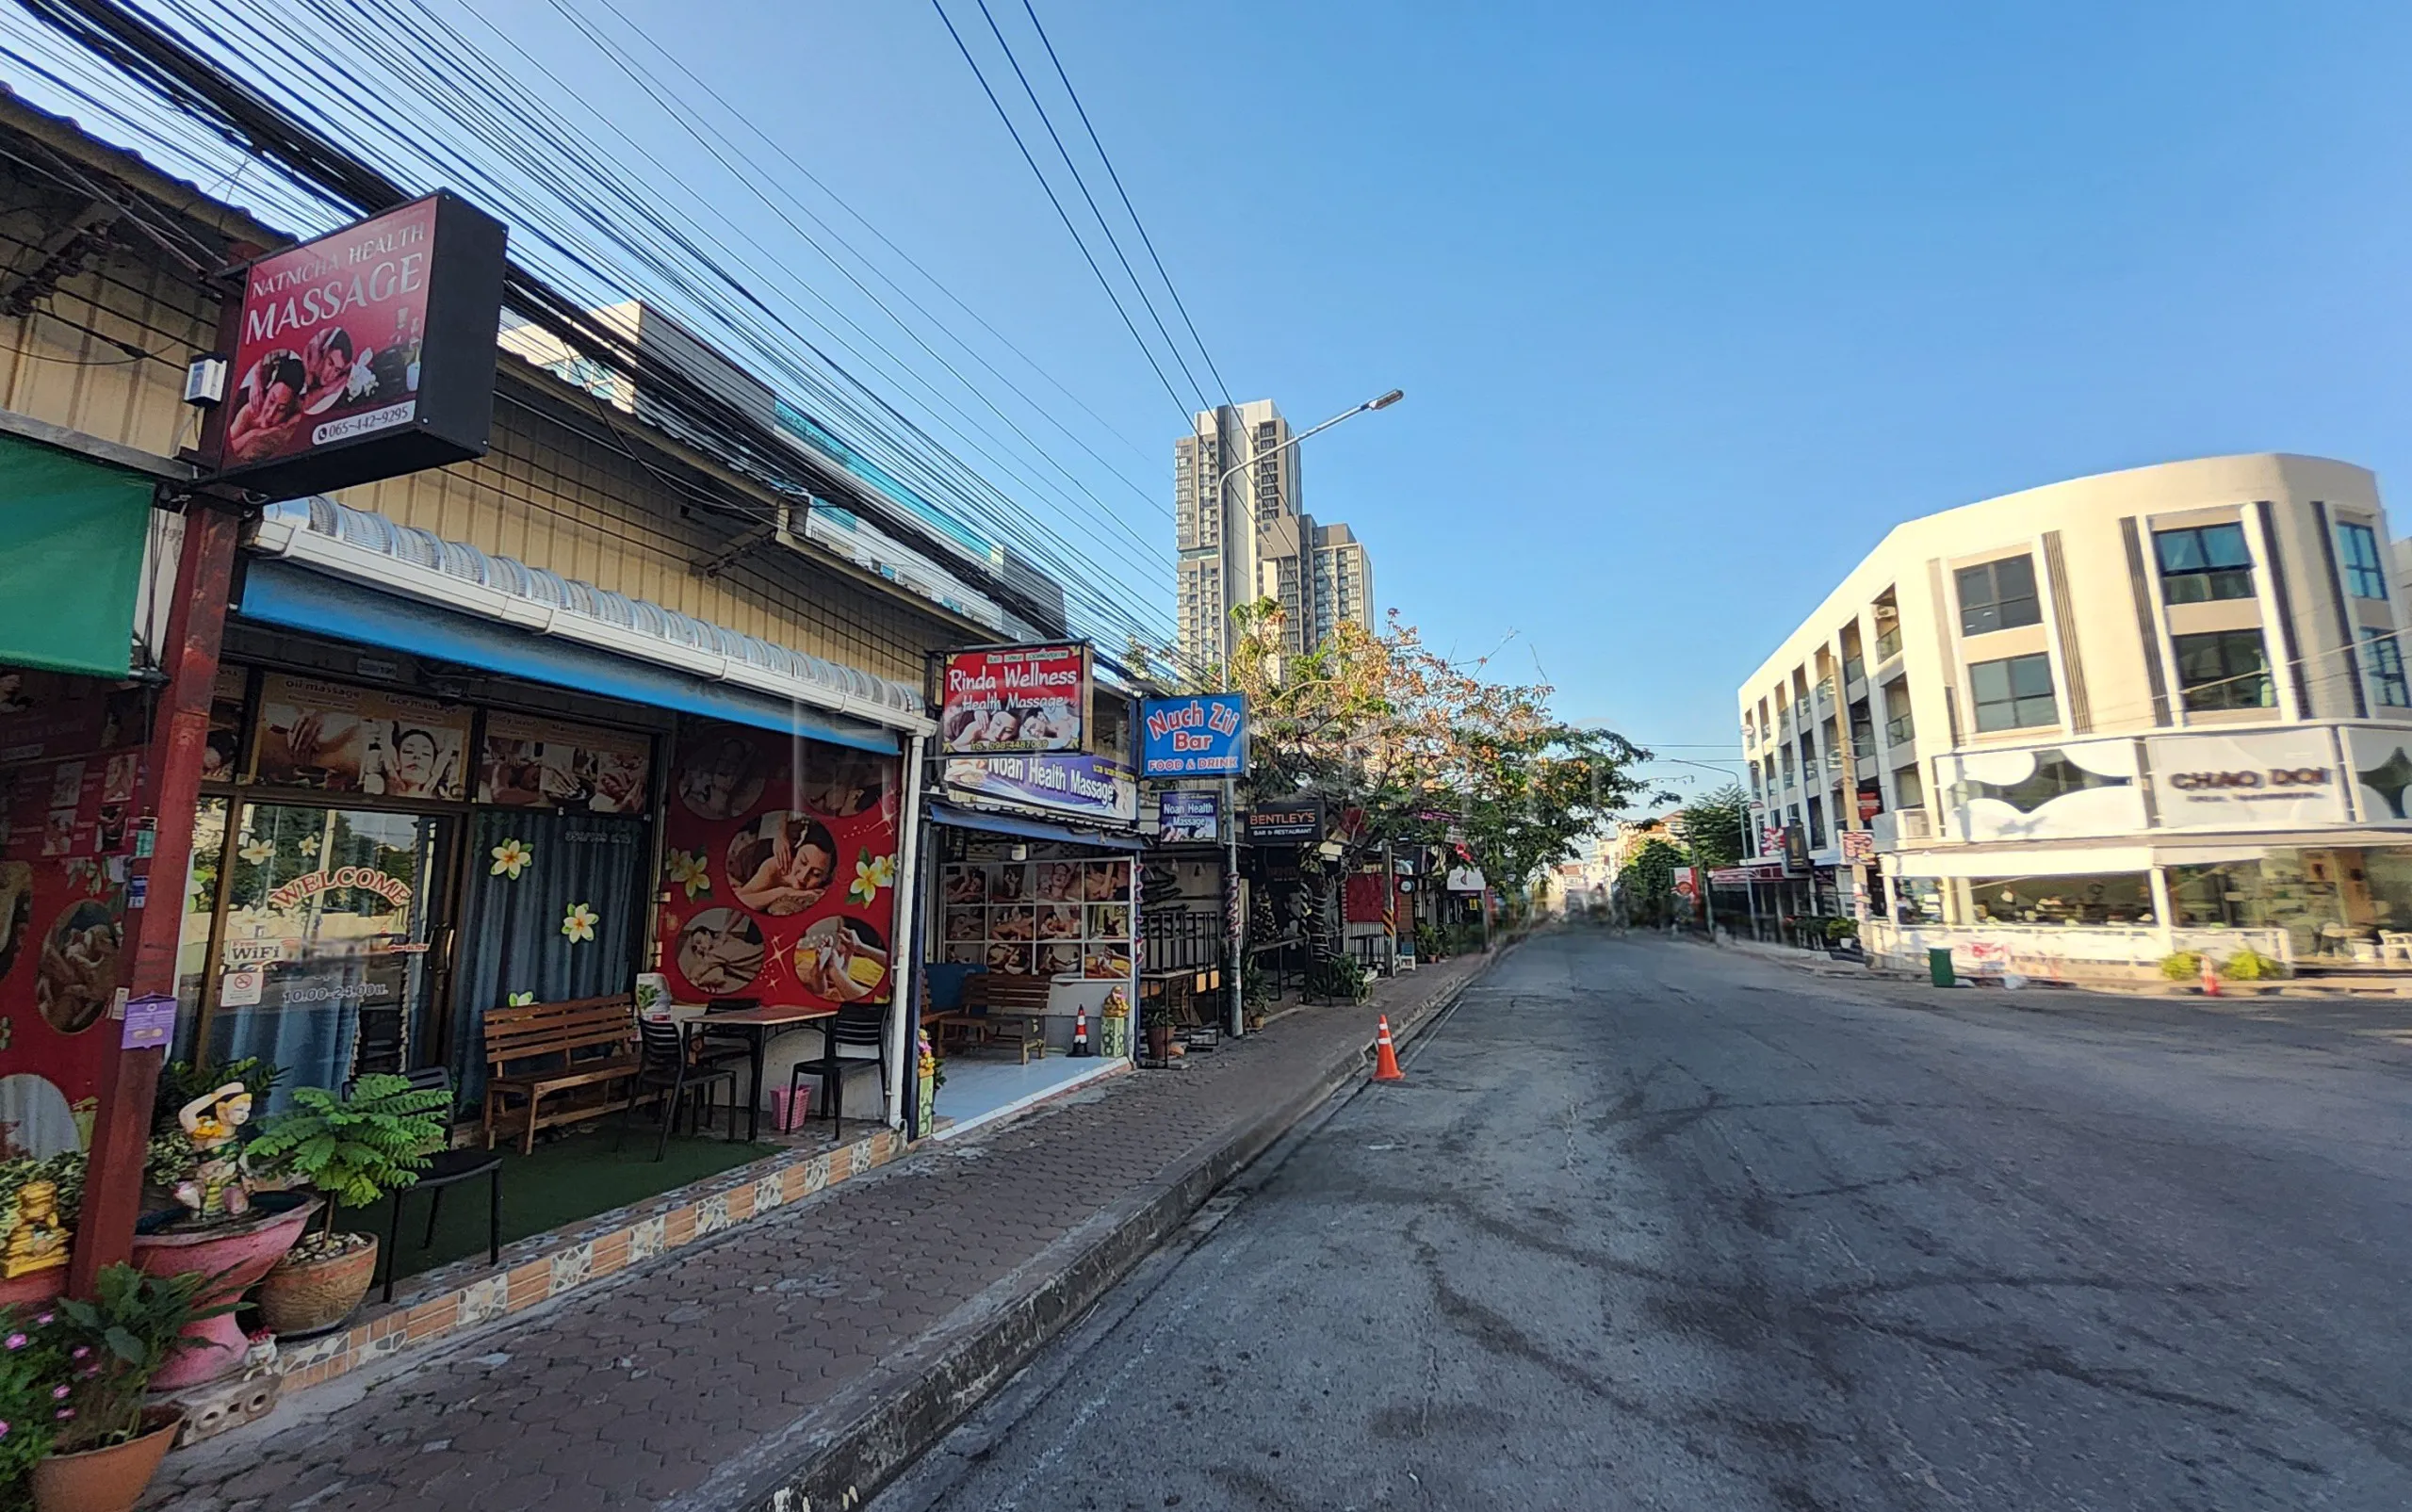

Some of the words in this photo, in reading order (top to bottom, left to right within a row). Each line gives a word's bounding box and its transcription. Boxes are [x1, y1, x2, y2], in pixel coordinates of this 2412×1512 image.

[253, 254, 339, 300] NATNICHA
[349, 222, 425, 266] HEALTH
[245, 252, 423, 346] MASSAGE
[949, 665, 996, 692] Rinda
[1003, 661, 1077, 689] Wellness
[962, 691, 1002, 714] Health
[1005, 692, 1067, 714] Massage
[1147, 700, 1204, 741] Nuch
[1208, 702, 1241, 737] Zii
[1174, 731, 1213, 752] Bar
[1149, 759, 1183, 772] FOOD
[1186, 758, 1196, 771] &
[1198, 756, 1238, 770] DRINK
[989, 758, 1023, 781] Noan
[1029, 758, 1066, 791] Health
[1070, 769, 1114, 805] Massage
[2169, 771, 2263, 790] CHAO
[1164, 804, 1184, 815] Noan
[1187, 803, 1214, 815] Health
[1249, 812, 1316, 825] BENTLEY'S
[1173, 817, 1206, 828] Massage
[269, 866, 412, 908] WELCOME
[232, 945, 280, 960] WiFi
